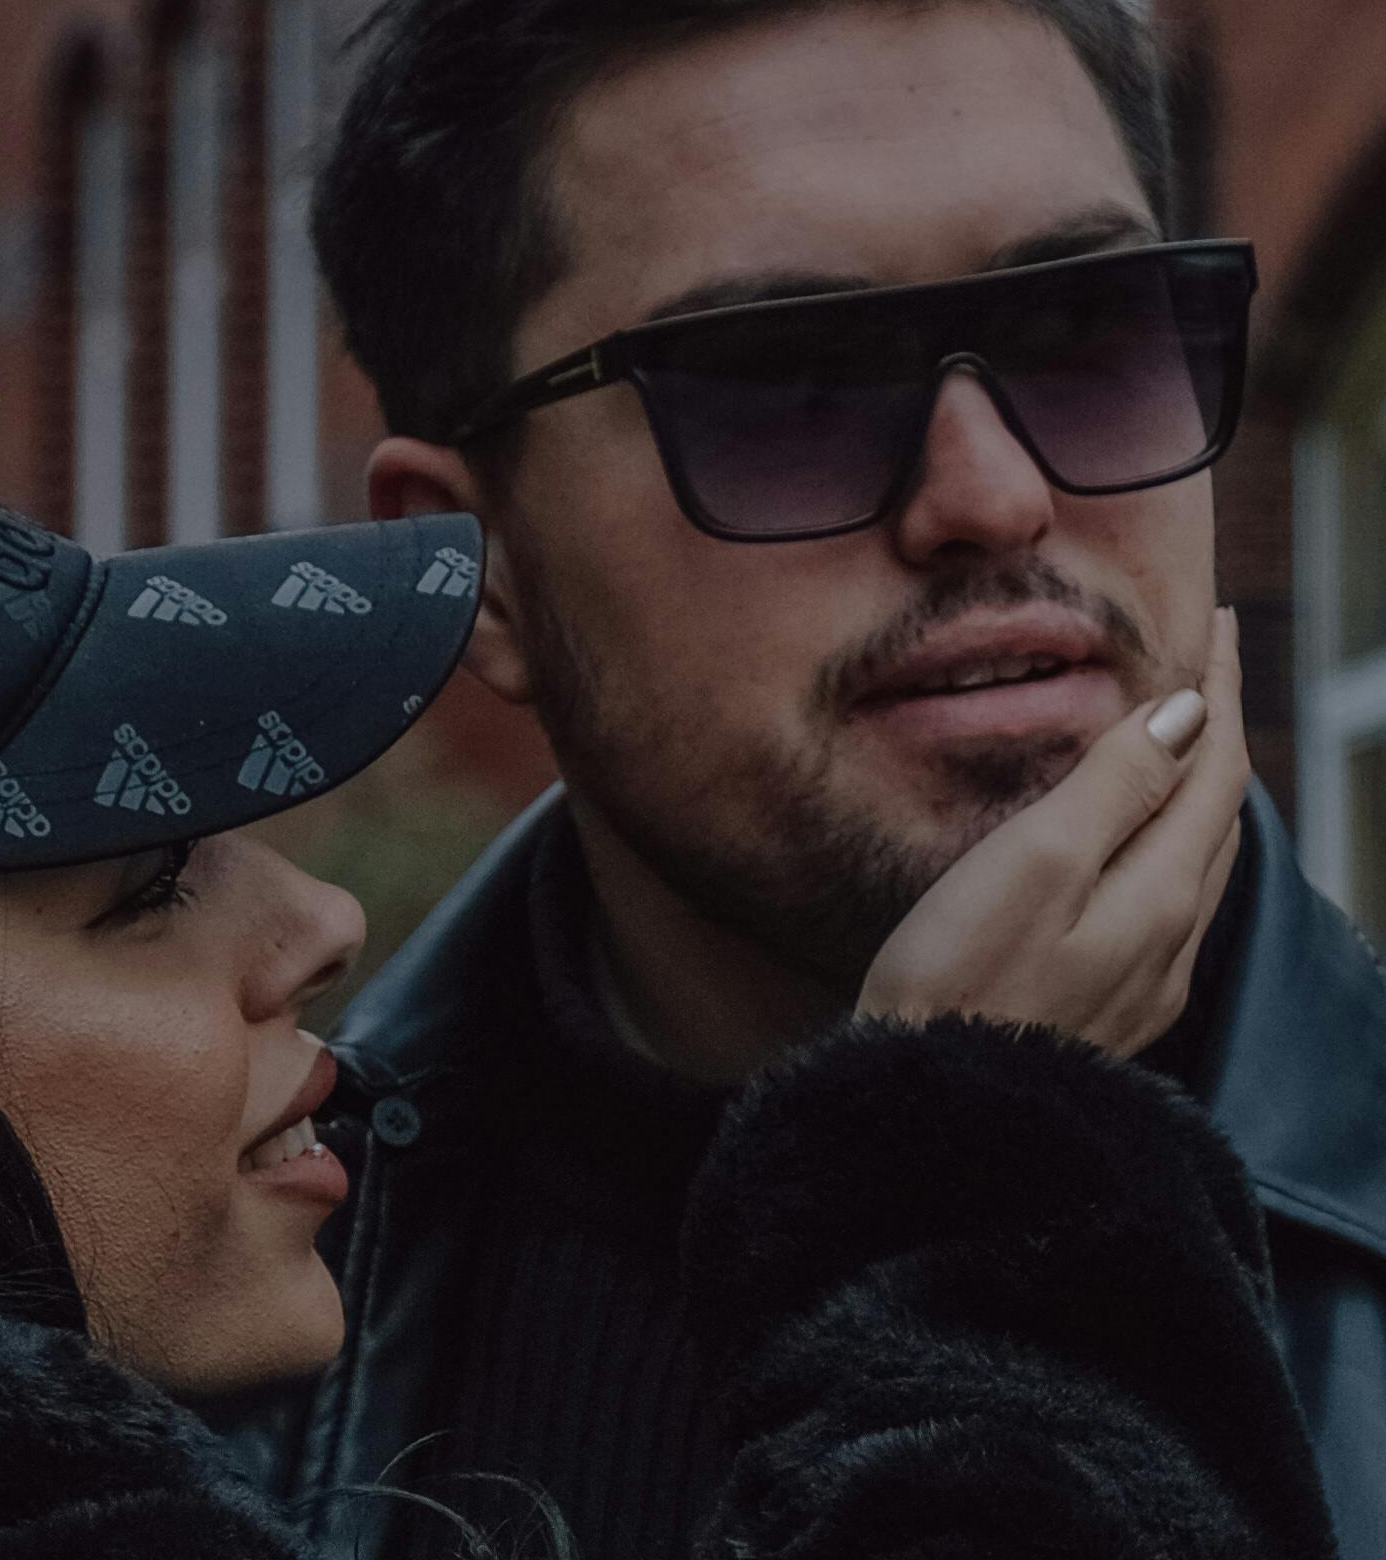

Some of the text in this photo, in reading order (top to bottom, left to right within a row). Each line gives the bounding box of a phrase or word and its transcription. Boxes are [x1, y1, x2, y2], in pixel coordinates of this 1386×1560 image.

[145, 575, 229, 626] adidas
[290, 561, 373, 615] adidas
[113, 723, 193, 817] adidas
[257, 710, 326, 788] didas
